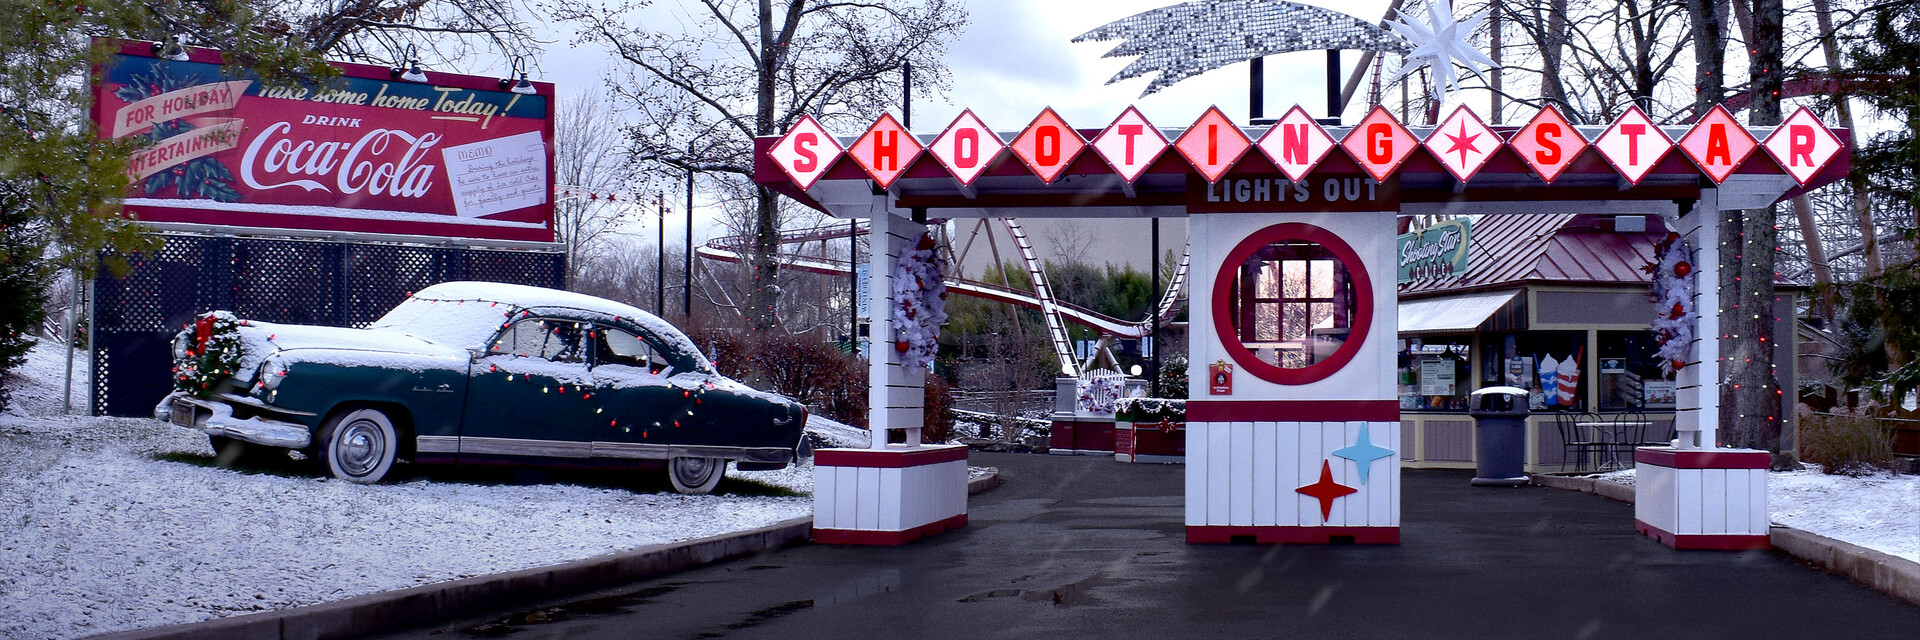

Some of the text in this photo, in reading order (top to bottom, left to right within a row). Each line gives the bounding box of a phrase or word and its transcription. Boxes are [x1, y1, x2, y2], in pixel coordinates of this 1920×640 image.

[126, 88, 231, 127] FOR HOLIDAY
[302, 114, 362, 128] DRINK
[310, 87, 368, 106] some
[371, 83, 429, 111] home
[433, 85, 521, 129] Today!
[128, 129, 232, 175] NTERTAINING
[240, 121, 443, 198] Coca-Cola
[458, 146, 492, 160] MEMO
[507, 155, 535, 166] holidays
[793, 122, 1816, 173] SHOOTING STAR
[506, 188, 518, 197] and
[1207, 178, 1380, 202] LIGHTS OUT
[1401, 229, 1461, 267] Shooting Star
